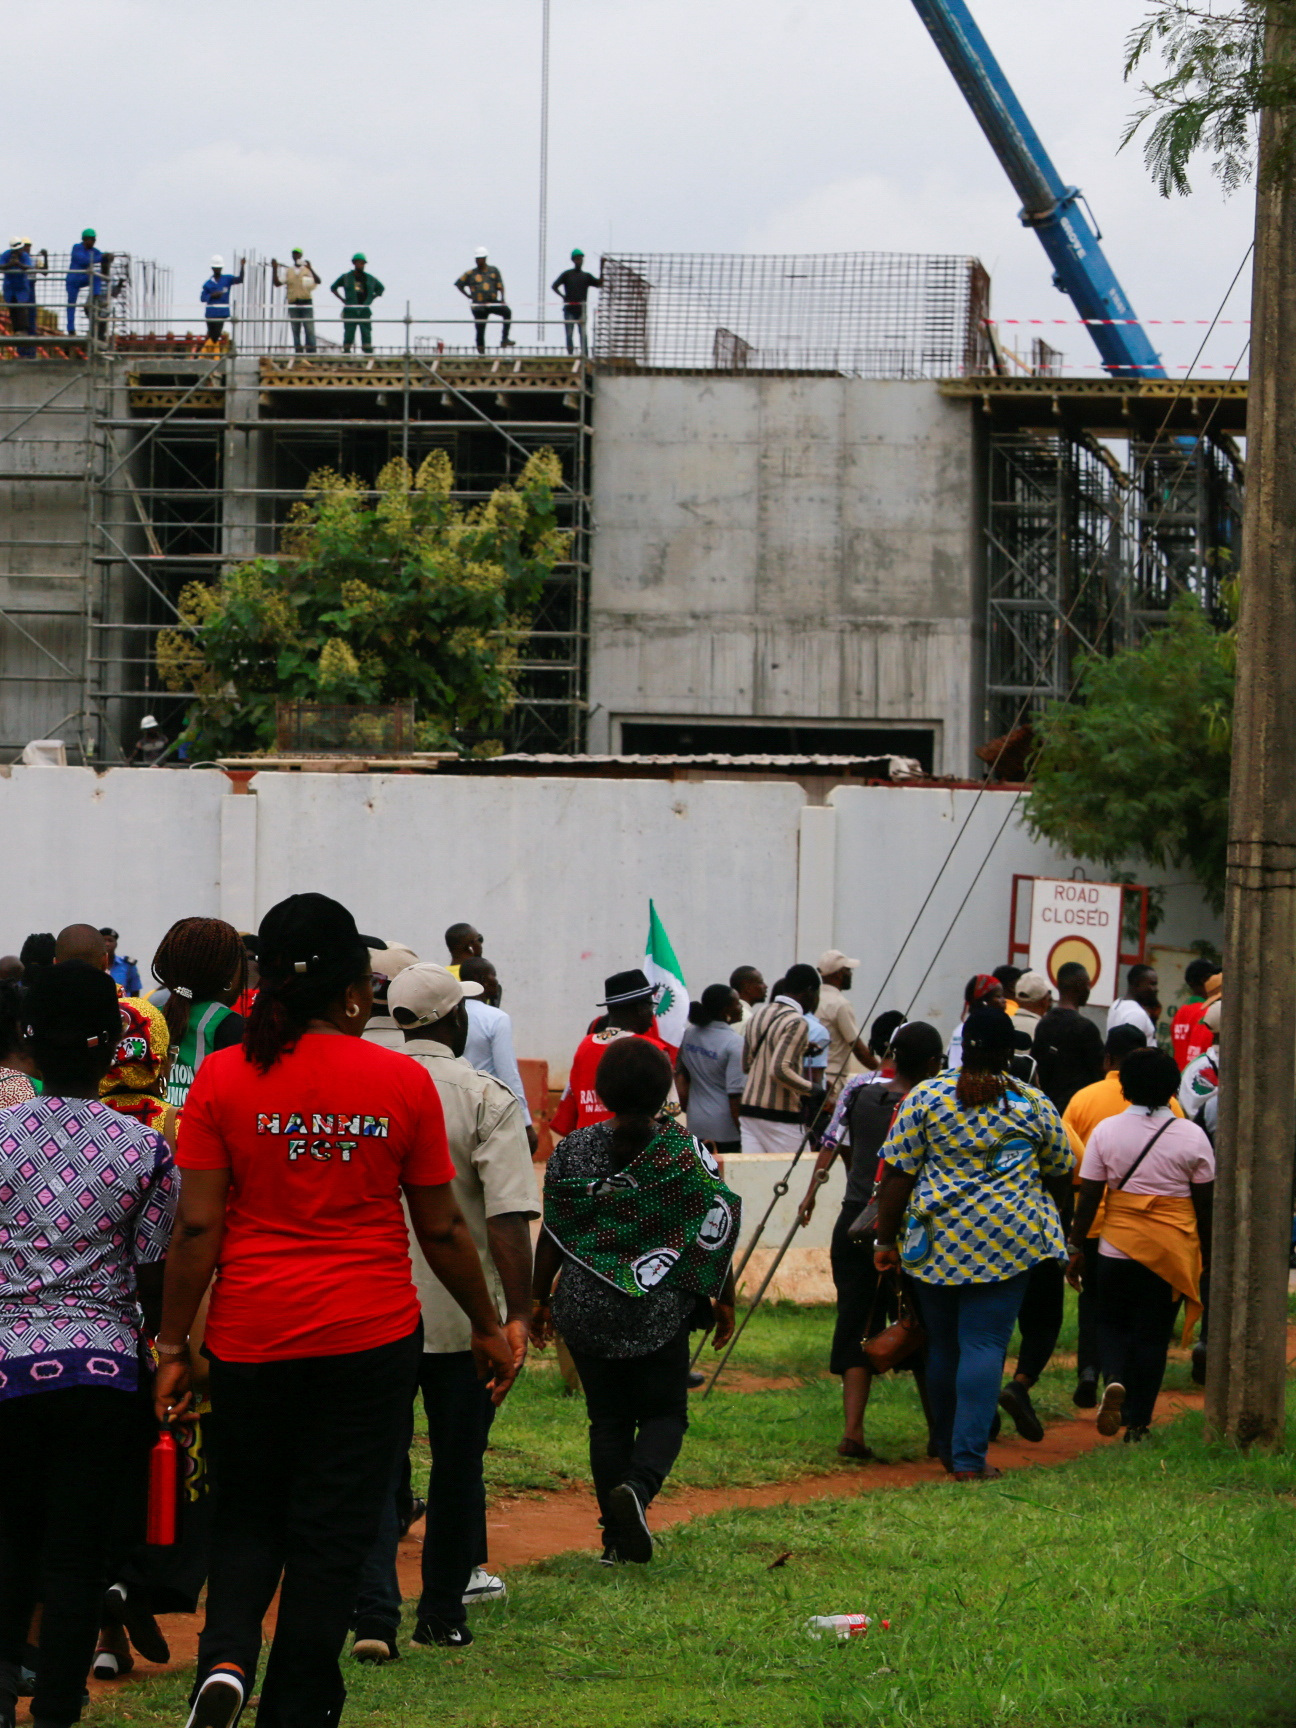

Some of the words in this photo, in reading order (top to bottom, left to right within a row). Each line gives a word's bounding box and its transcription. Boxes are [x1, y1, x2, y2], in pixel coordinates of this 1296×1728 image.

[1054, 884, 1100, 904] ROAD
[1041, 907, 1110, 927] CLOSED
[257, 1112, 390, 1138] NANNM
[288, 1139, 359, 1161] FCT
